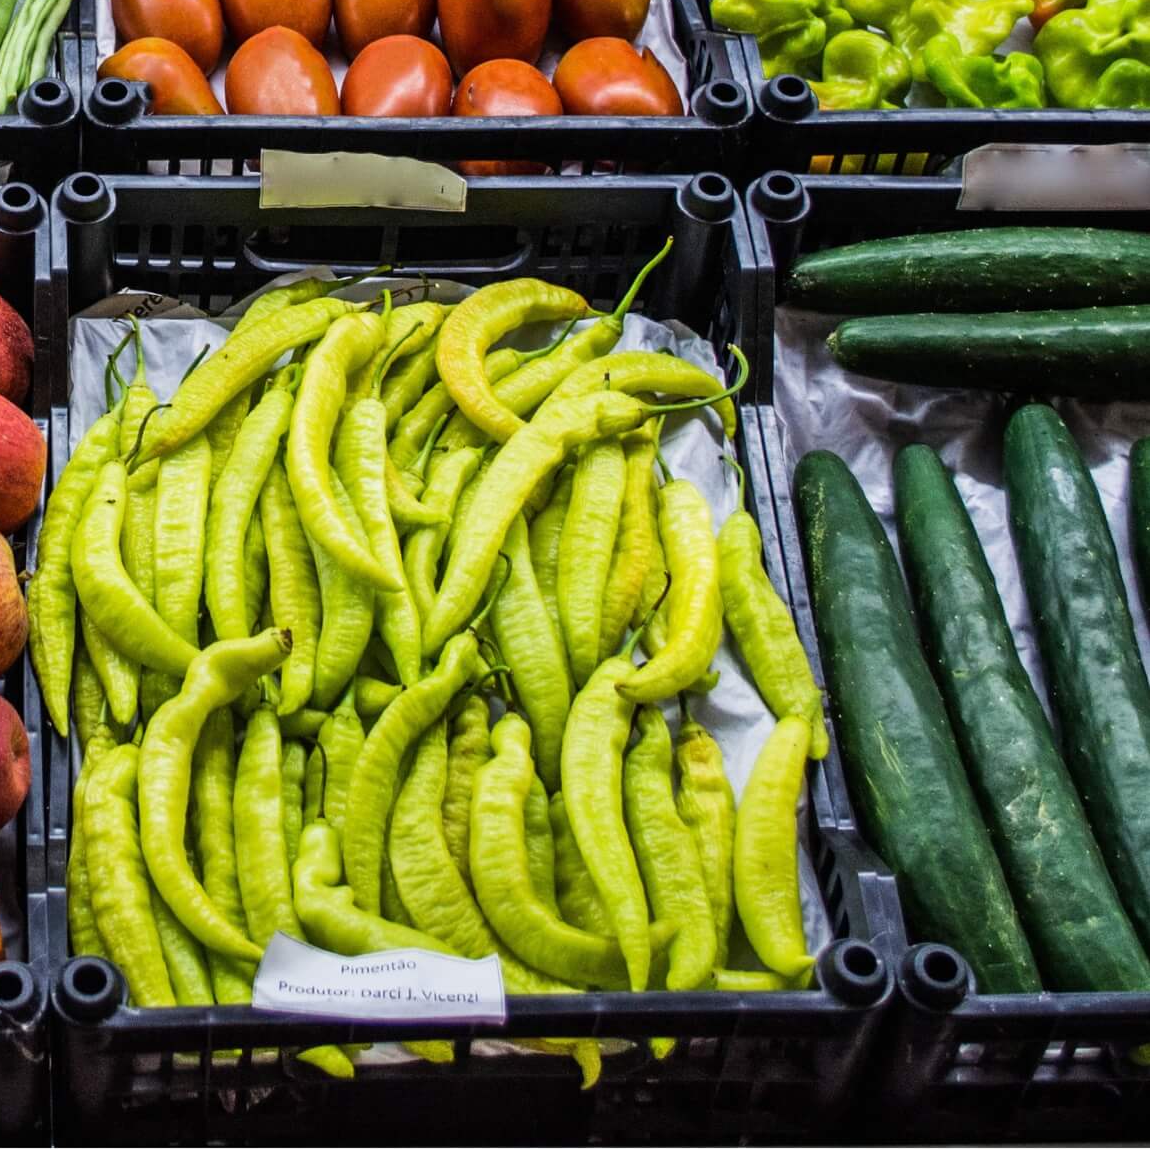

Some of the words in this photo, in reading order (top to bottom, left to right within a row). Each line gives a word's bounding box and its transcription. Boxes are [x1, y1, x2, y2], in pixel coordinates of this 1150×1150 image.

[341, 959, 417, 975] Pimentão
[278, 979, 354, 997] Produtor:
[361, 986, 401, 1000] Darci
[421, 988, 479, 1003] Vicenzi
